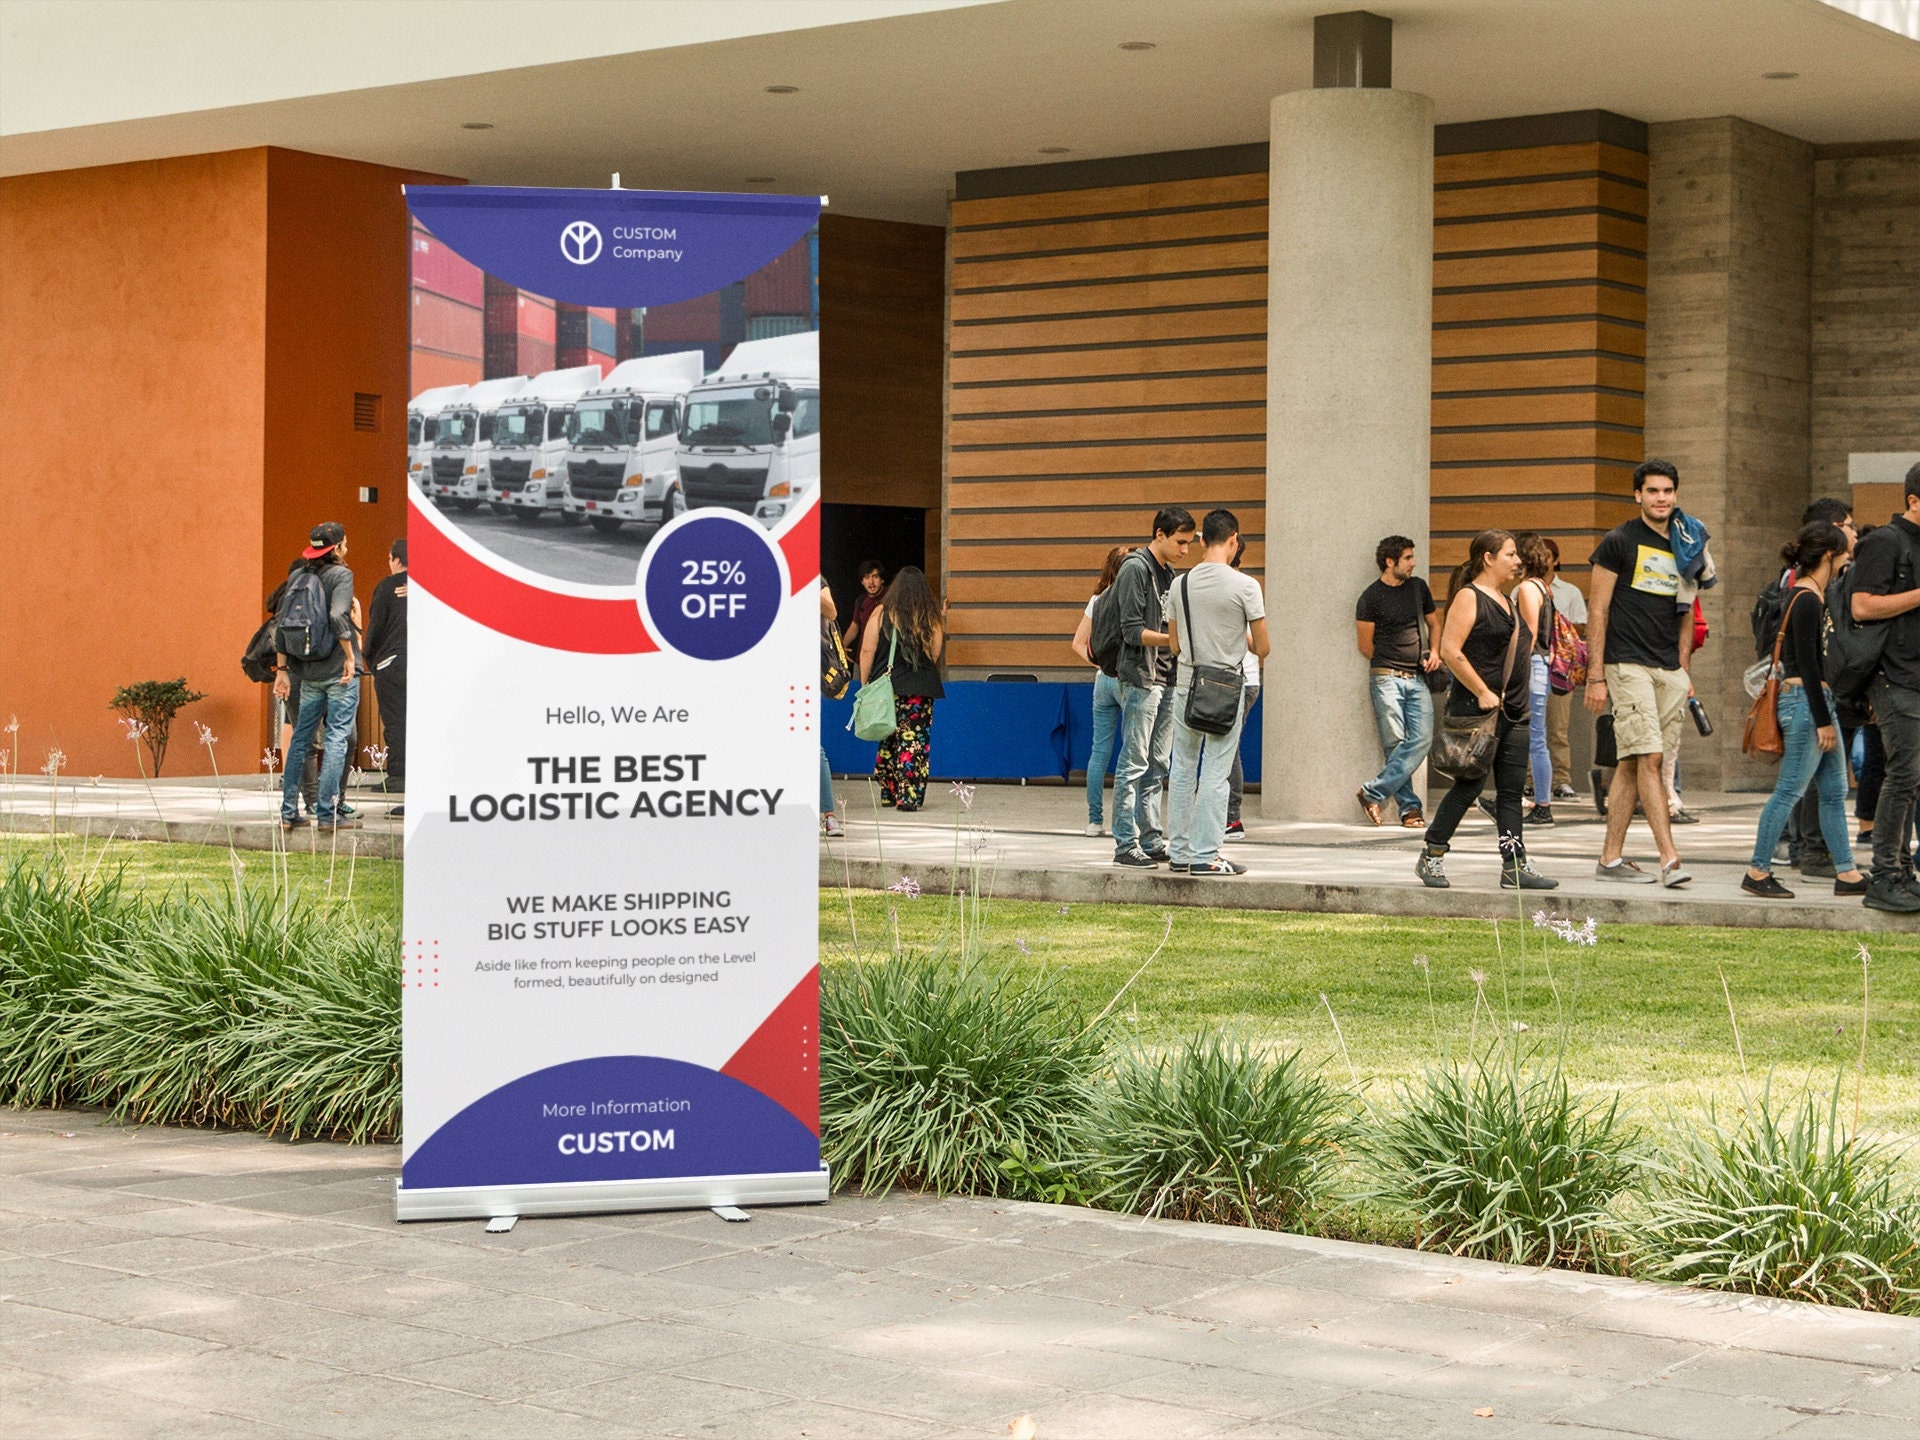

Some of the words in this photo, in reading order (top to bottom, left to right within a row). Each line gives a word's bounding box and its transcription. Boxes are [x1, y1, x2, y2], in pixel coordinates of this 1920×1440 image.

[612, 226, 677, 240] CUSTOM
[612, 245, 683, 263] Company
[681, 560, 746, 586] 25%
[681, 593, 747, 619] OFF
[546, 705, 605, 727] Hello,
[610, 706, 647, 724] We
[652, 705, 690, 723] Are
[526, 755, 602, 785] THE
[614, 754, 707, 783] BEST
[449, 791, 620, 823] LOGISTIC
[629, 788, 785, 819] AGENCY
[506, 895, 545, 914] WE
[552, 893, 618, 913] MAKE
[623, 890, 731, 911] SHIPPING
[488, 922, 527, 941] BIG
[533, 920, 604, 940] STUFF
[610, 917, 688, 937] LOOKS
[694, 915, 751, 935] EASY
[474, 959, 512, 972] Aside
[514, 958, 538, 971] like
[540, 957, 572, 970] from
[575, 956, 628, 970] keeping
[631, 954, 676, 969] people
[678, 955, 695, 966] on
[698, 952, 721, 965] the
[723, 951, 756, 964] Level
[513, 975, 565, 989] formed,
[568, 973, 637, 988] beautifully
[639, 975, 657, 985] on
[658, 970, 719, 986] designed
[542, 1103, 587, 1118] More
[591, 1097, 691, 1116] Information
[557, 1128, 675, 1155] CUSTOM
